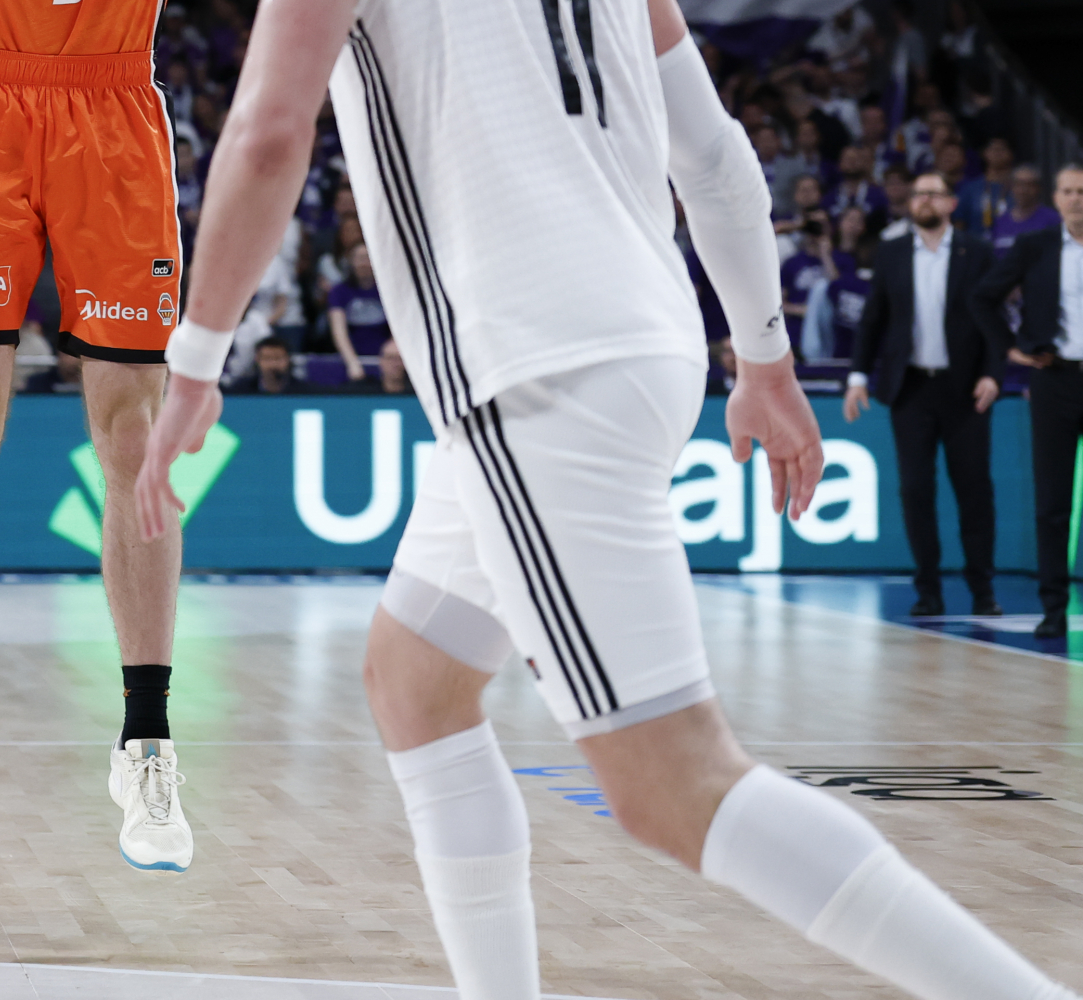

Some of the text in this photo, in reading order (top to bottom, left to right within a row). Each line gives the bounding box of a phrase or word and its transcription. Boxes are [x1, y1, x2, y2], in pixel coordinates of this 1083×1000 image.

[153, 265, 169, 275] acb
[79, 300, 149, 321] Midea
[292, 409, 879, 572] Uaja
